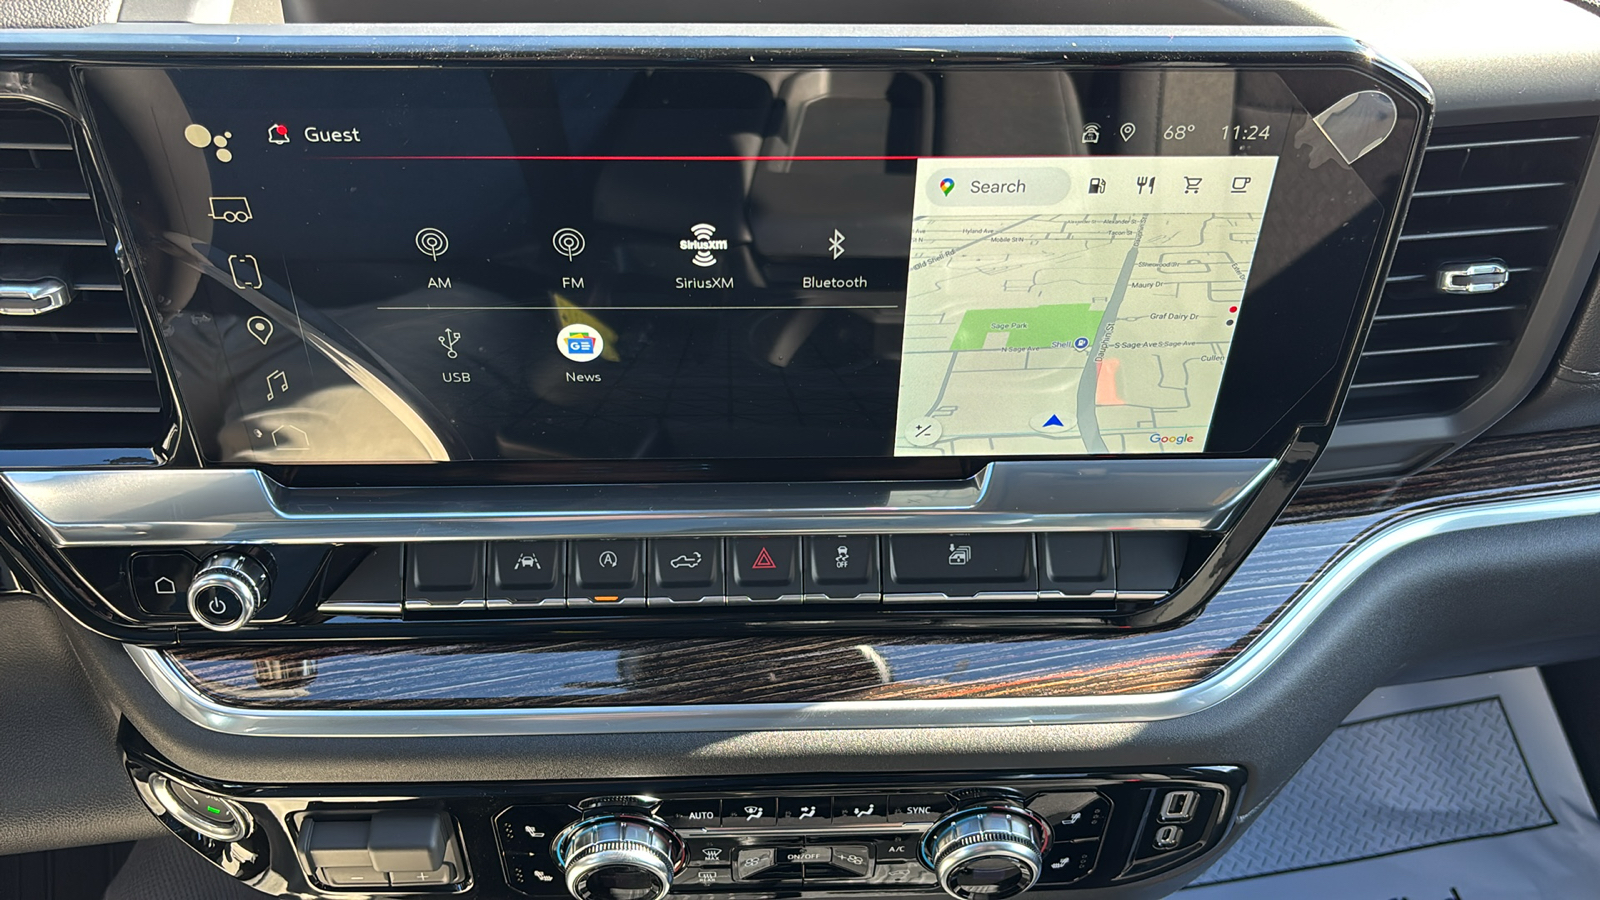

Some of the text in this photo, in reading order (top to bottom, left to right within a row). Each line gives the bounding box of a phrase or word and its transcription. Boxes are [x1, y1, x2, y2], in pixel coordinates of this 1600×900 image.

[304, 126, 361, 144] Guest
[1221, 125, 1271, 141] 11:24
[970, 179, 1027, 195] Search
[912, 249, 955, 271] Old Shell Rd
[427, 277, 452, 289] AM
[562, 277, 585, 289] FM
[675, 276, 734, 289] SiriusXM
[802, 276, 868, 288] Bluetooth
[1168, 313, 1188, 321] Dairy
[1052, 341, 1072, 349] Shell
[1094, 323, 1115, 362] Dauphin St
[442, 372, 471, 384] USB
[565, 371, 602, 383] News
[1150, 433, 1194, 445] Google
[603, 553, 613, 565] A
[836, 560, 848, 568] OFF
[688, 811, 714, 820] AUTO
[906, 805, 931, 815] SYNC
